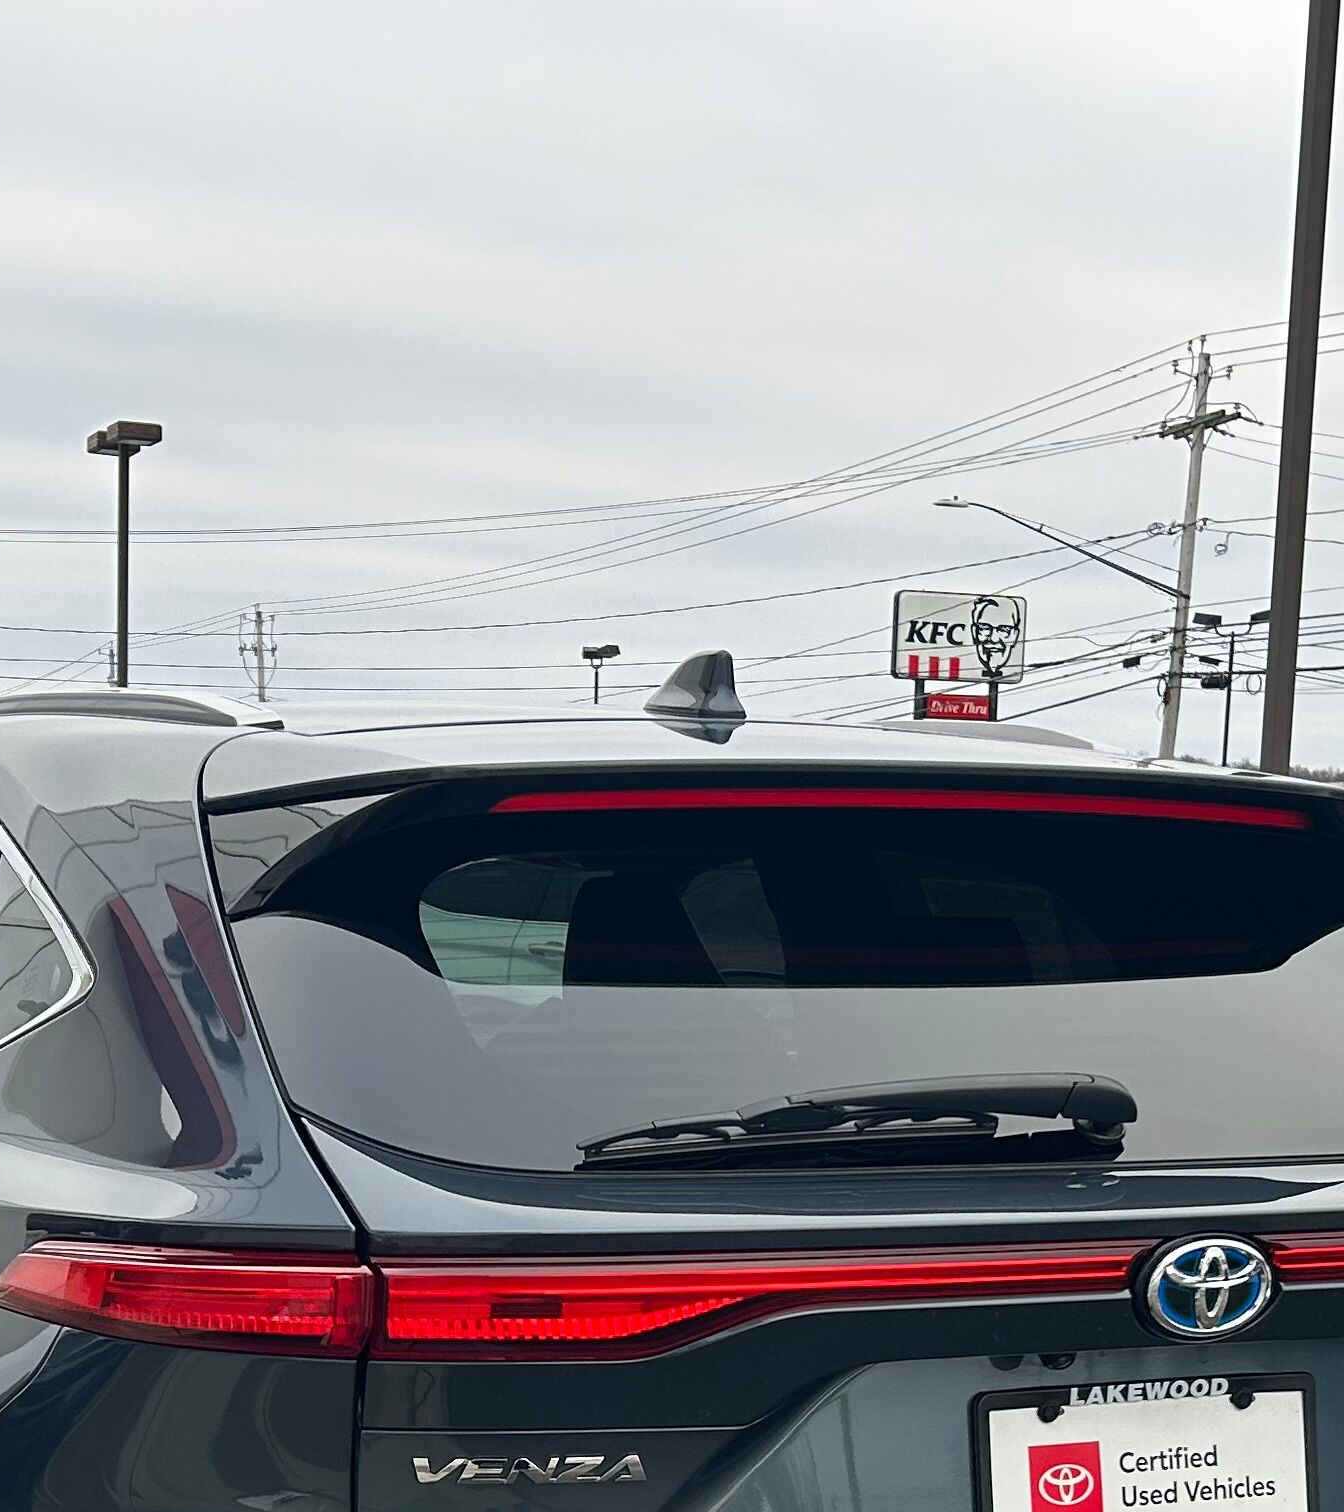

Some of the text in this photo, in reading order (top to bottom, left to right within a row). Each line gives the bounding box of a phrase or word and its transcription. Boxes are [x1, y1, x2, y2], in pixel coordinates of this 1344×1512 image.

[905, 620, 966, 646] KFC
[930, 700, 988, 716] Drive Thru
[1069, 1377, 1230, 1407] LAKEWOOD
[412, 1453, 648, 1485] VENZA
[1118, 1444, 1219, 1474] Certified
[1121, 1475, 1277, 1508] Used Vehicles
